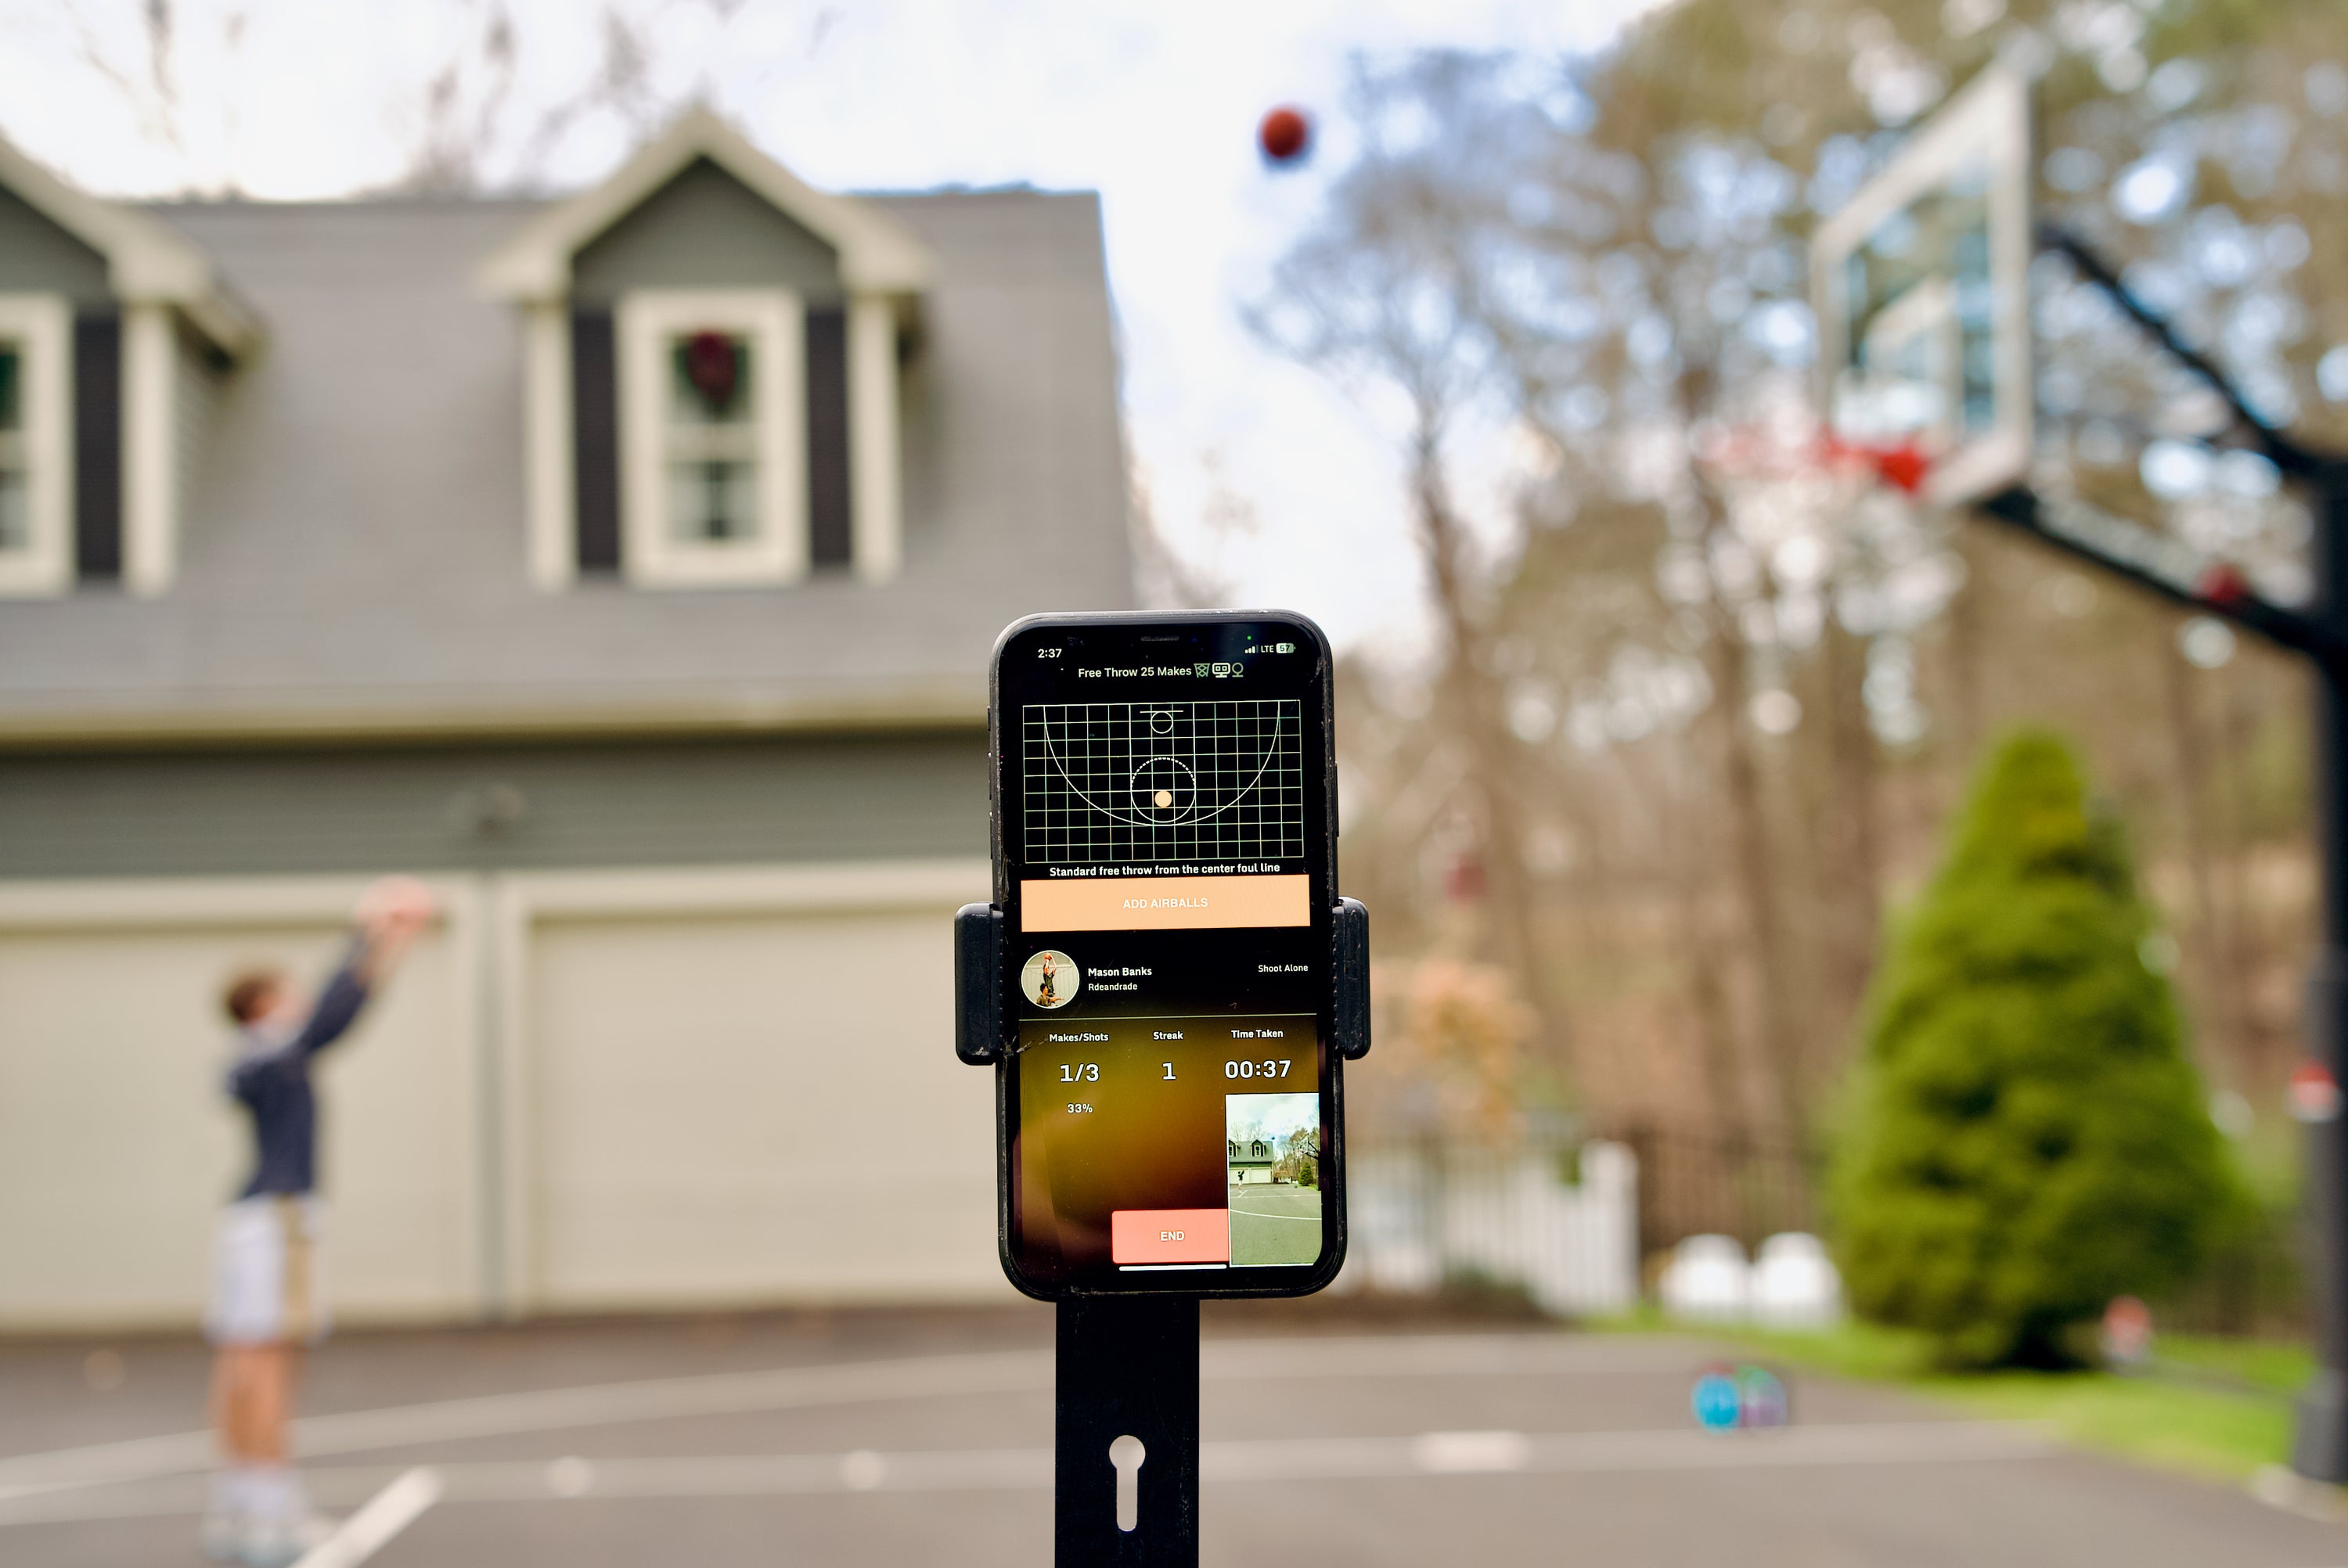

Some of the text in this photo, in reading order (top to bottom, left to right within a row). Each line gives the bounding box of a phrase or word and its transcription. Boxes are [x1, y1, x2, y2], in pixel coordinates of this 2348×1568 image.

[1037, 648, 1062, 659] 2:37
[1260, 645, 1275, 653] LTE
[1078, 666, 1192, 678] Free Throw 25 Makes
[1050, 862, 1280, 877] Standard free throw from the center foul line
[1122, 897, 1208, 909] ADD AIRBALLS
[1088, 966, 1153, 977] Mason Banks
[1258, 963, 1309, 973] Shoot Alone
[1088, 982, 1138, 991] Rdeandrade
[1049, 1032, 1110, 1042] Makes/Shots
[1153, 1030, 1183, 1040] Streak
[1230, 1029, 1284, 1038] Time Taken
[1059, 1063, 1100, 1082] 1/3
[1162, 1063, 1176, 1080] 1
[1224, 1059, 1291, 1079] 00:37
[1067, 1103, 1093, 1113] 33%
[1160, 1231, 1185, 1242] END
